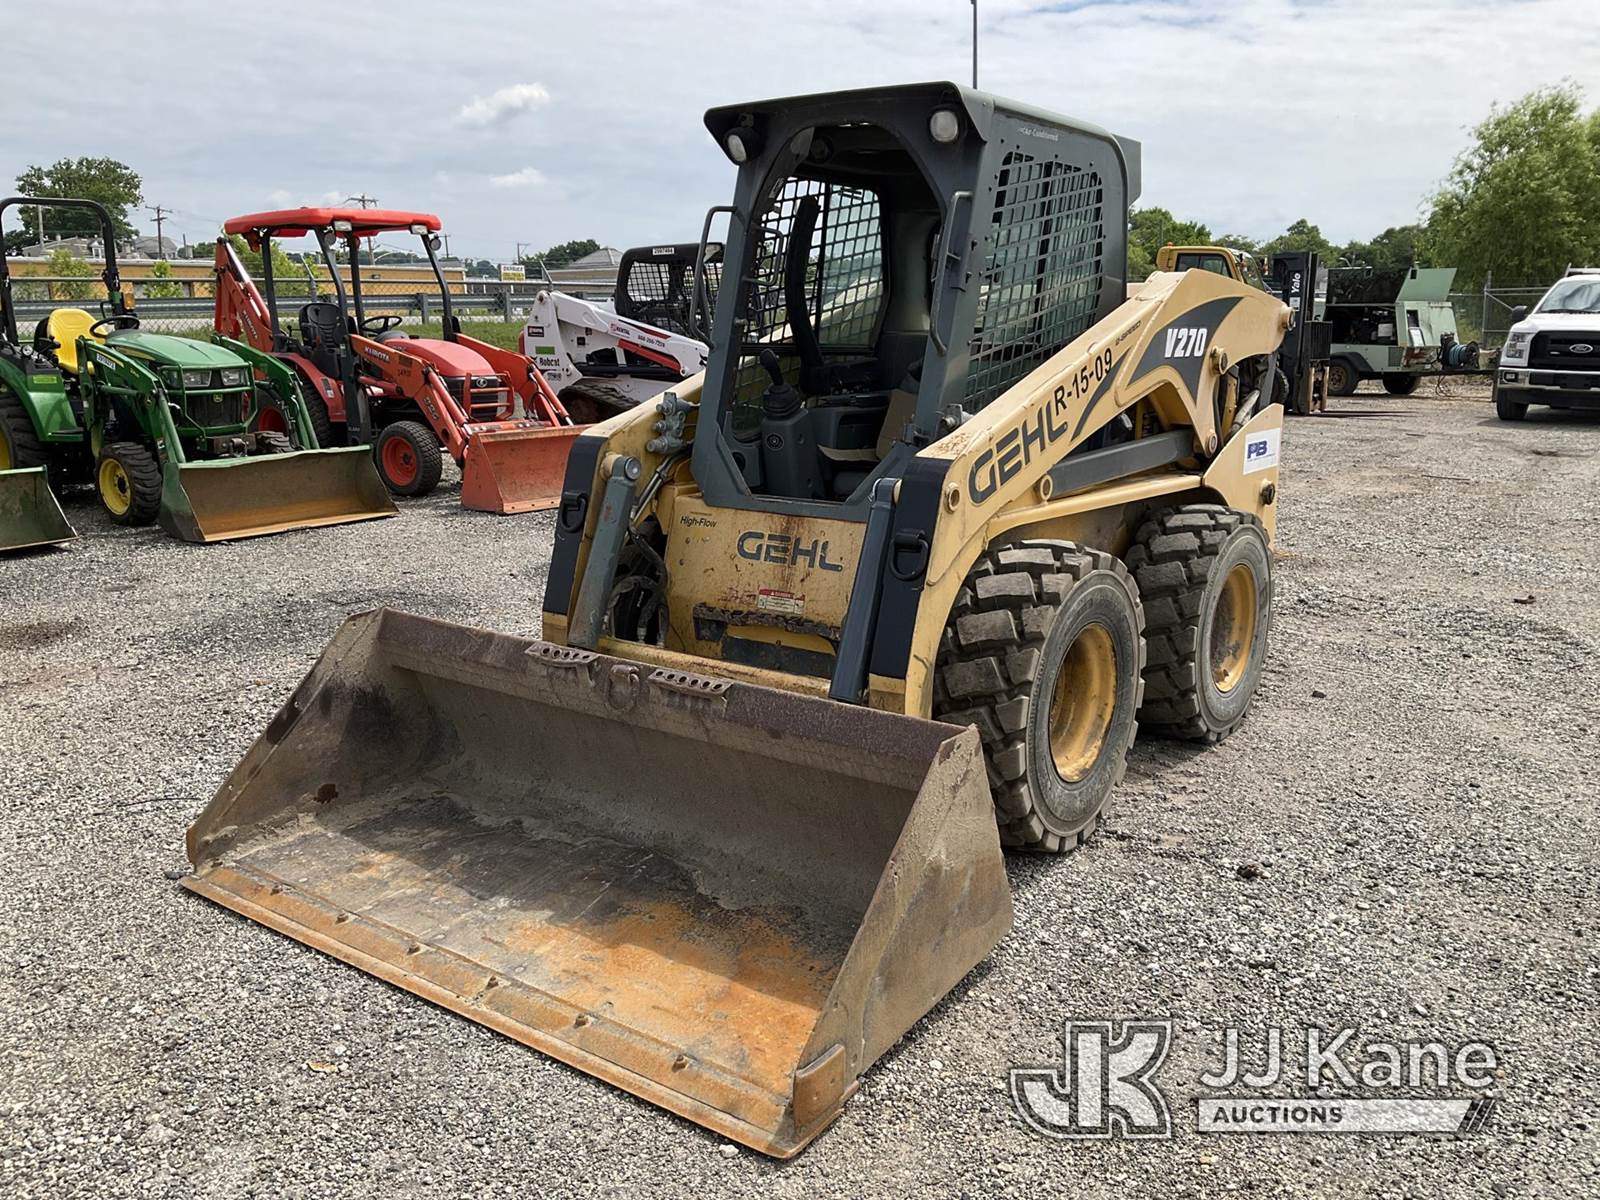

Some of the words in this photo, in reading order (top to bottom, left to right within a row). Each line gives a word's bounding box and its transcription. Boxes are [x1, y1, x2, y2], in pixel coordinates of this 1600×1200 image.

[364, 345, 390, 362] KUBOTA
[1164, 328, 1208, 358] V270
[539, 356, 560, 367] Bobcat
[1053, 347, 1112, 416] R-15-09
[968, 400, 1069, 505] GEHL
[1247, 440, 1268, 459] PB
[680, 515, 717, 529] High-Flow
[736, 530, 844, 572] GEHL
